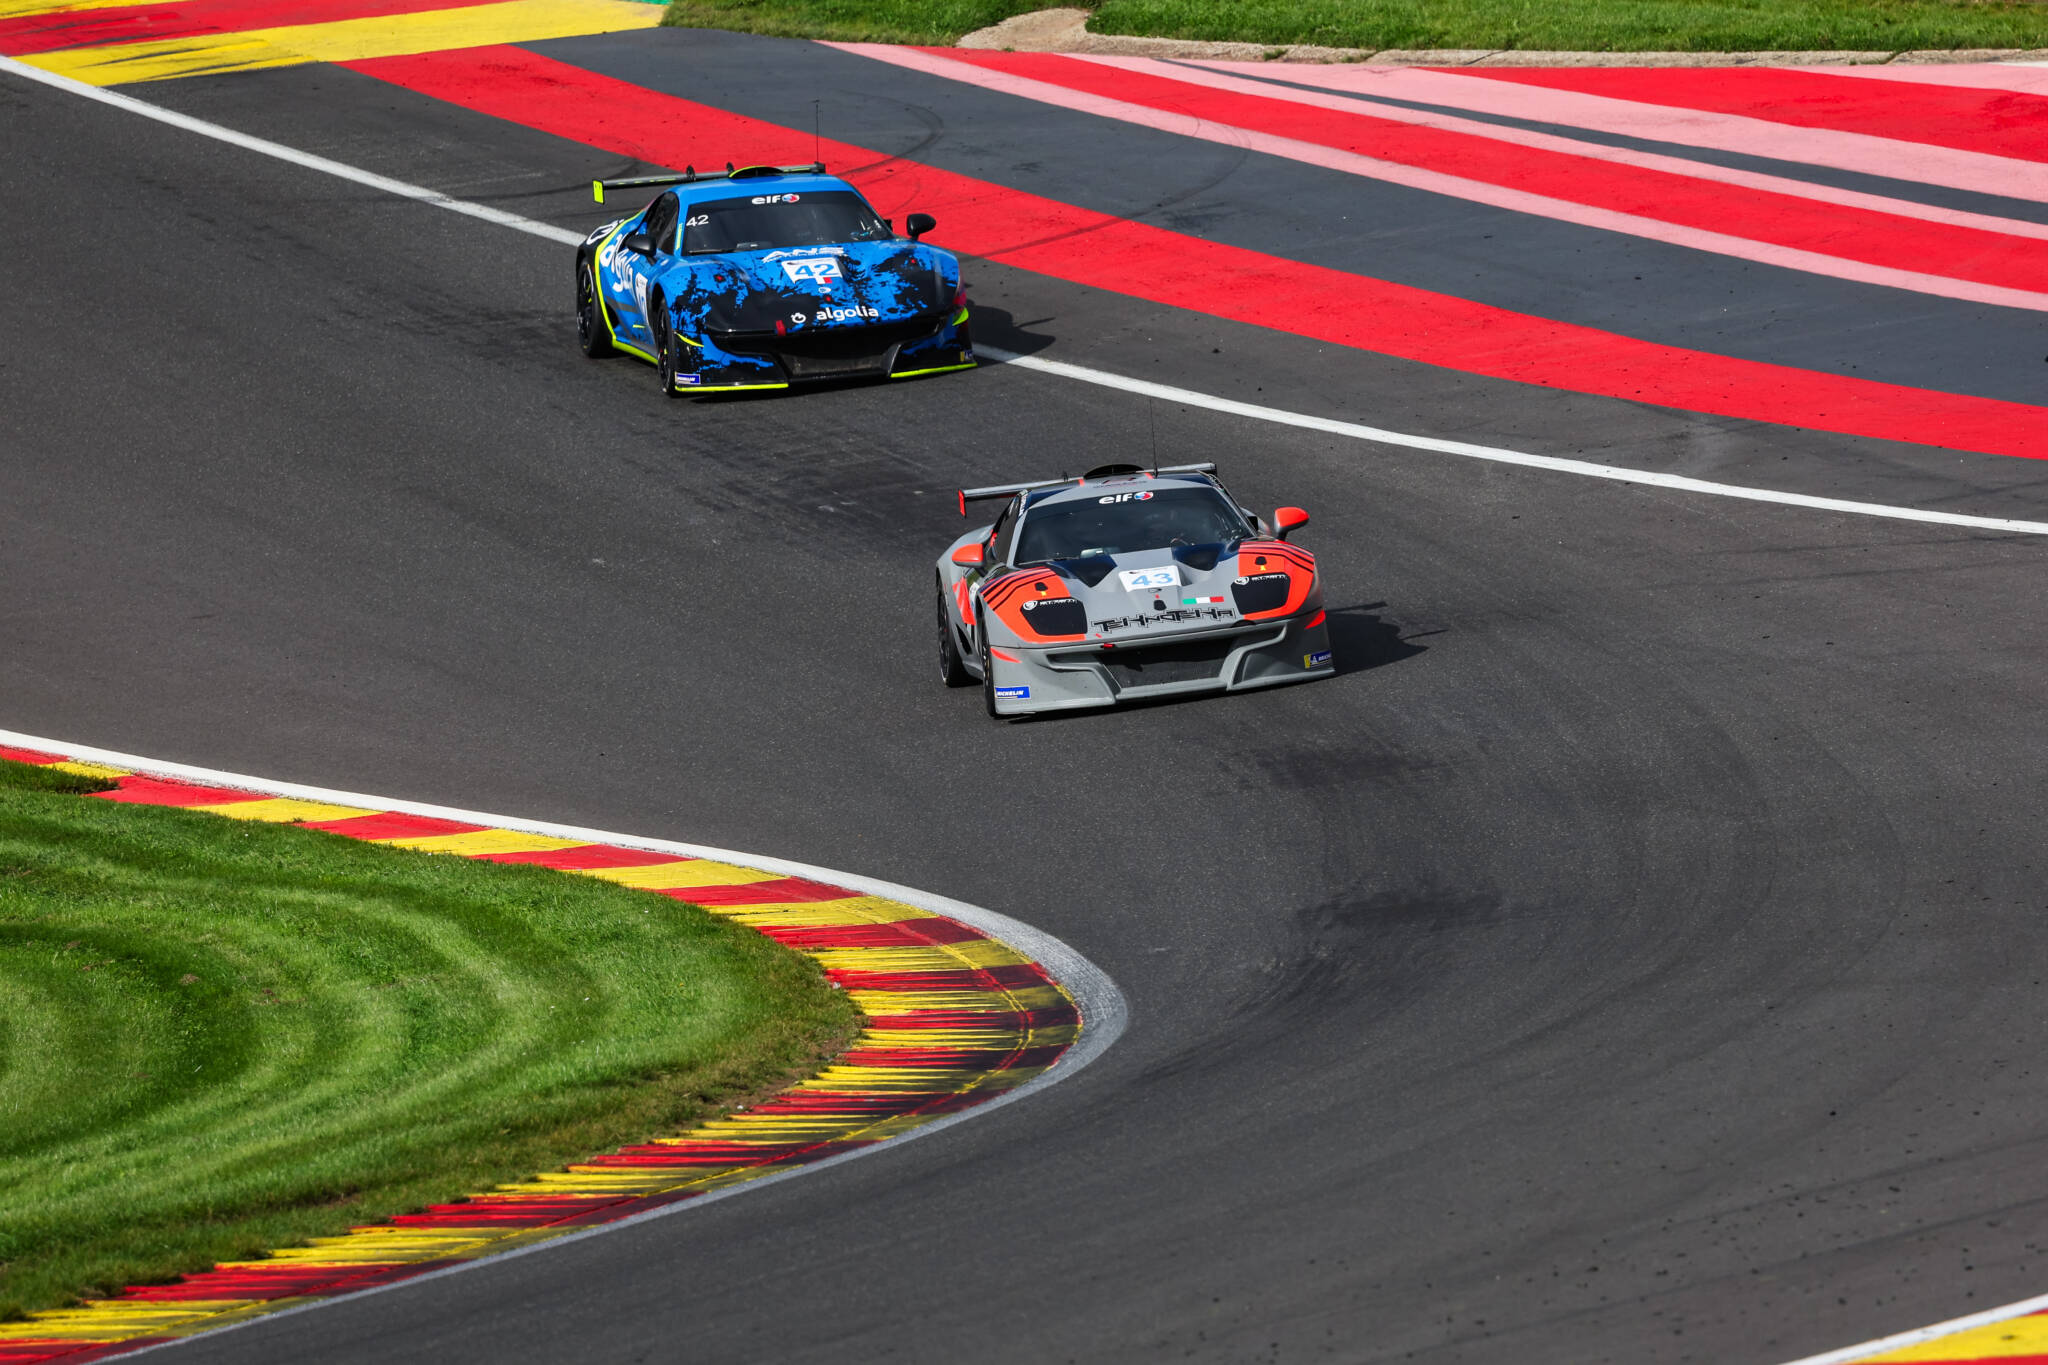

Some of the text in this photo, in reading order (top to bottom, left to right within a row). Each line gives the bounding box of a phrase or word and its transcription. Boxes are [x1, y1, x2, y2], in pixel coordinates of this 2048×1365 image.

[752, 195, 781, 204] elf
[686, 214, 709, 226] 42
[795, 263, 837, 277] 42
[816, 305, 879, 321] algolia
[1099, 493, 1133, 504] elf
[1131, 573, 1173, 586] 43
